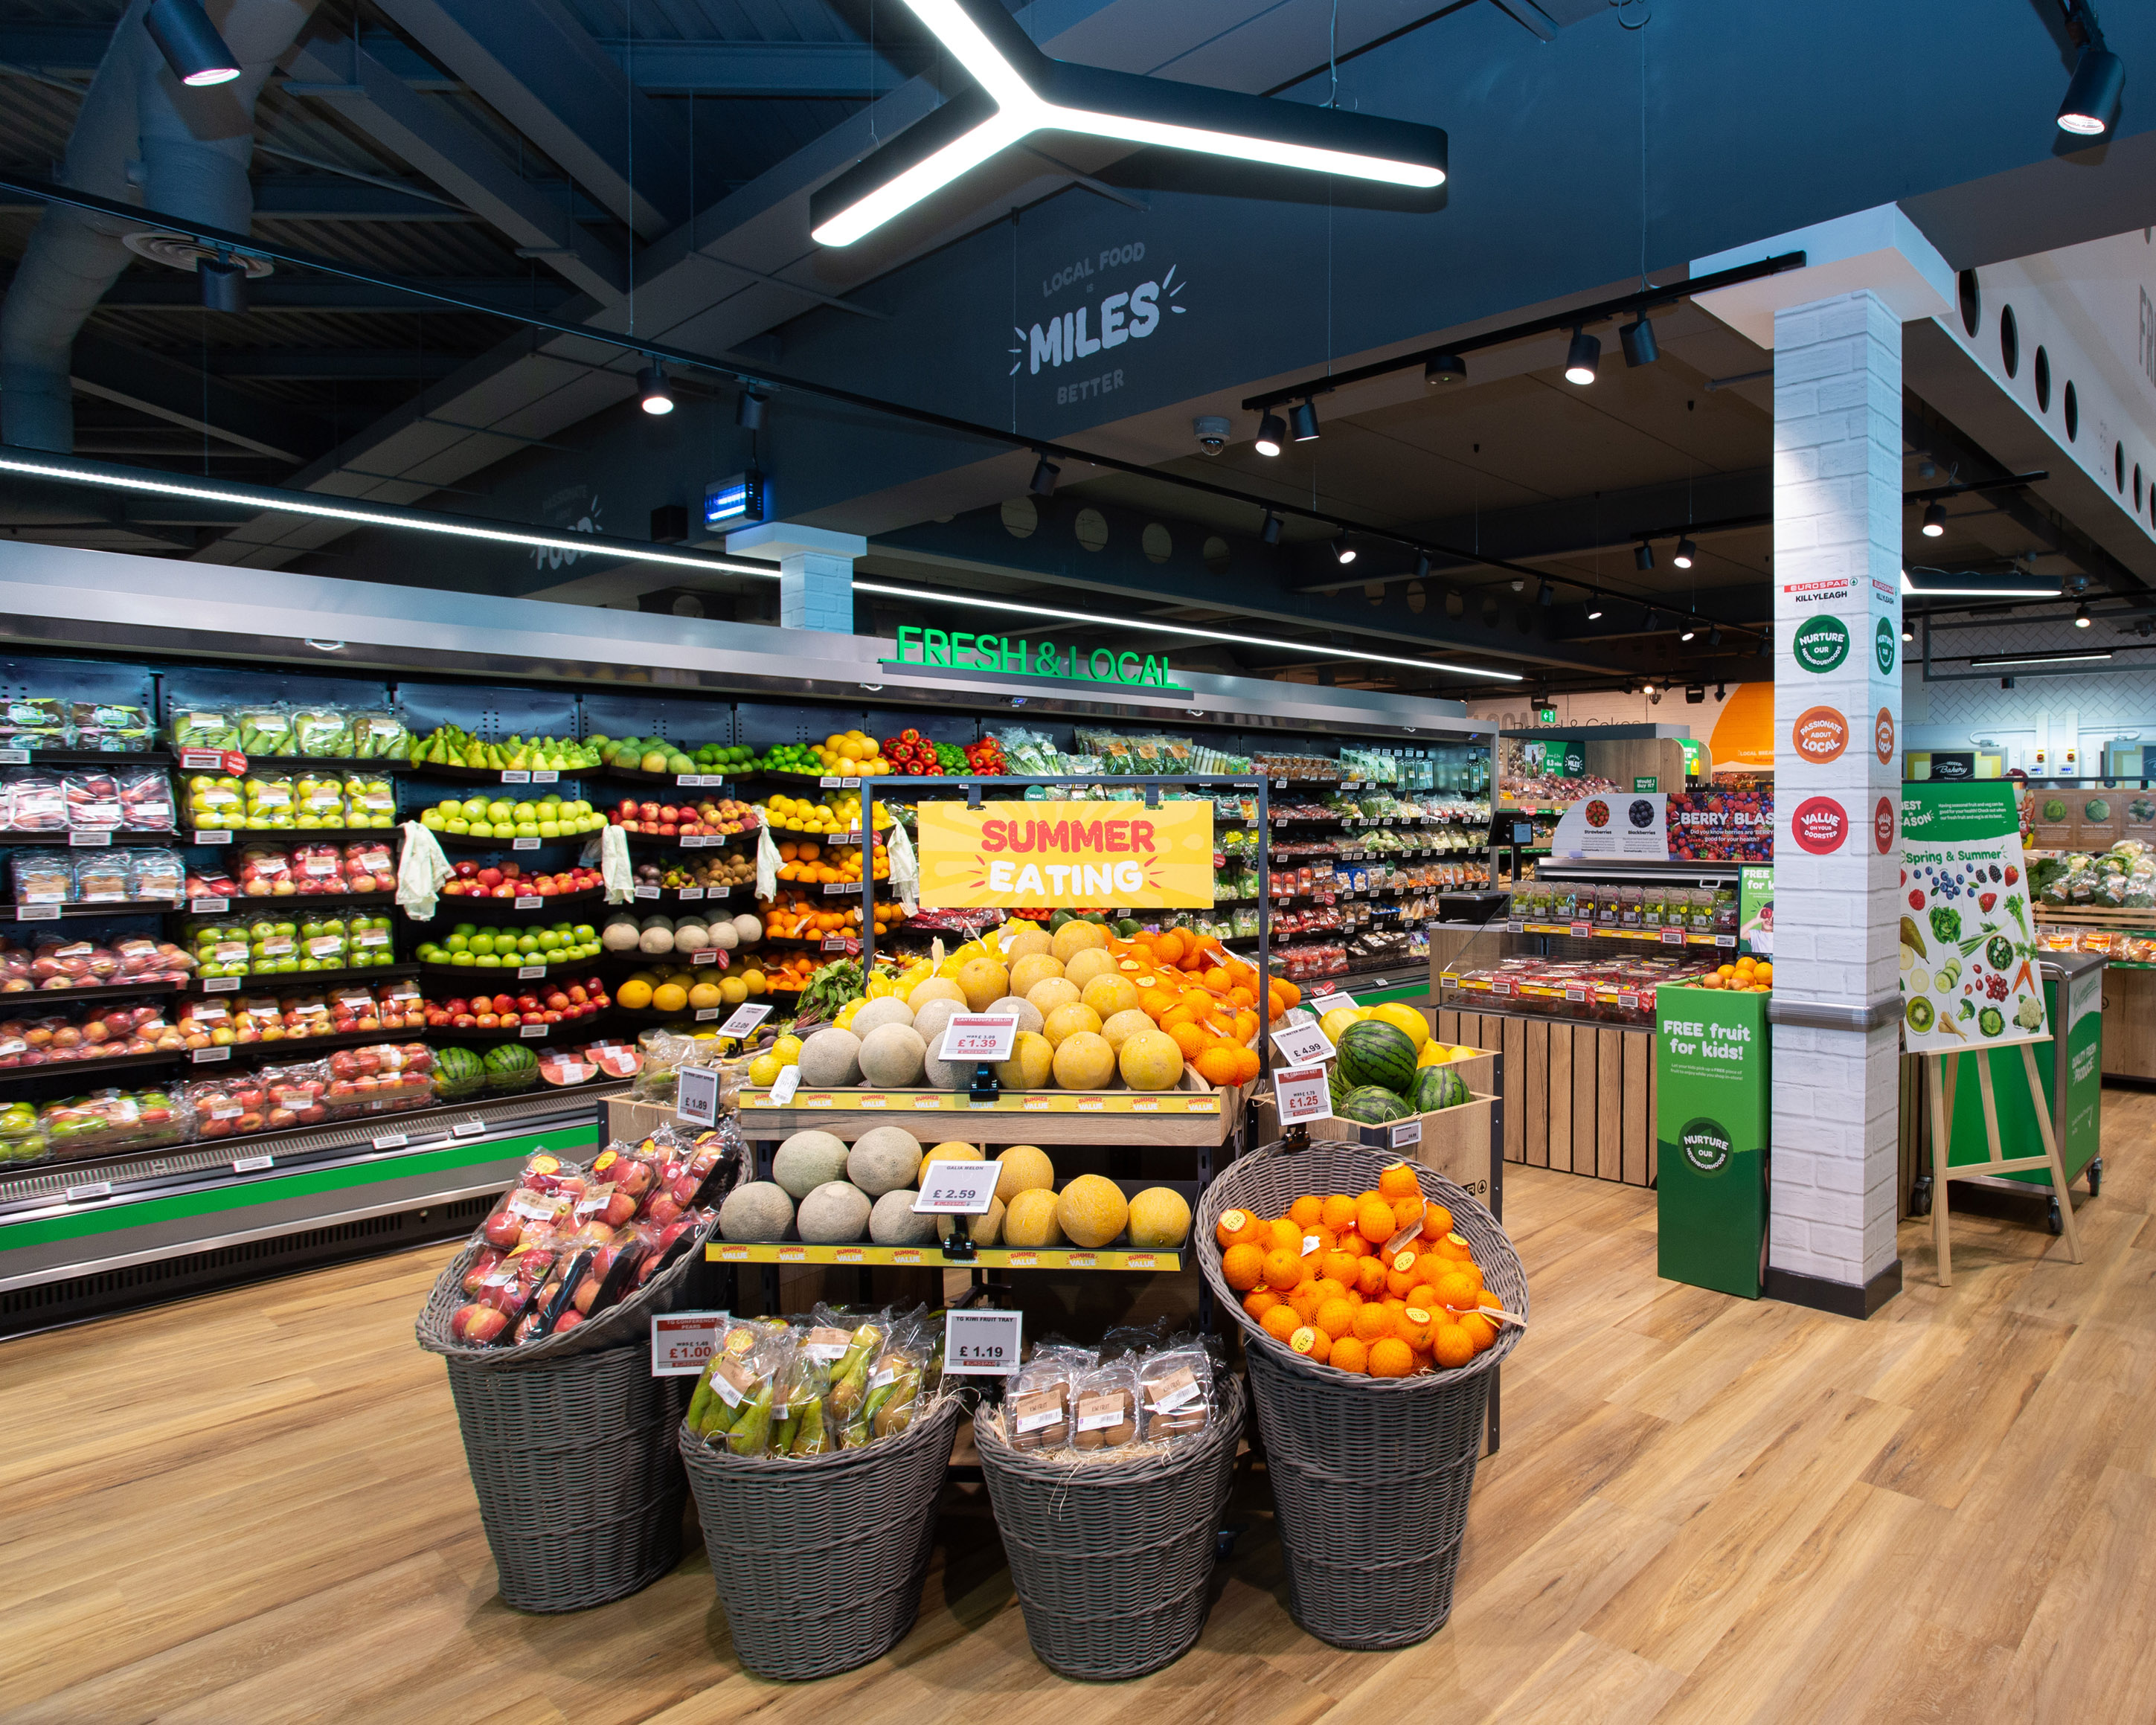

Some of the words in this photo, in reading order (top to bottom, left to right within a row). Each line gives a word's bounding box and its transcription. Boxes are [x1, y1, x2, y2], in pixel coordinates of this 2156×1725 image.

[1043, 257, 1094, 298] LOCAL
[1099, 242, 1146, 271] FOOD
[1030, 280, 1160, 375] MILES
[1057, 369, 1124, 405] BETTER
[1791, 579, 1848, 591] EUROSPAR
[1795, 591, 1847, 603] KILLYLEAGH
[1799, 632, 1845, 646] NURTURE
[897, 626, 1027, 673] FRESH
[1034, 641, 1062, 676] &
[1069, 646, 1178, 687] LOCAL
[1801, 646, 1842, 665] NEIGHBOURHOODS
[1800, 720, 1843, 736] PASSIONATE
[1802, 739, 1841, 753] LOCAL
[1936, 765, 1968, 775] Bakery
[1681, 812, 1730, 825] BERRY
[1800, 812, 1841, 826] VALUE
[1902, 812, 1933, 826] ASON
[981, 820, 1155, 853] SUMMER
[1804, 830, 1838, 839] DOORSTEP
[1906, 850, 1942, 866] Spring
[1946, 851, 1954, 861] &
[1957, 850, 2002, 861] Summer
[989, 860, 1143, 896] EATING
[1743, 869, 1771, 878] FREE
[1747, 880, 1764, 890] for
[1663, 1020, 1704, 1037] FREE
[1710, 1023, 1751, 1042] fruit
[969, 1039, 996, 1047] 1.39
[1302, 1043, 1321, 1055] 4.99
[1669, 1038, 1696, 1055] for
[1702, 1041, 1744, 1061] kids!
[692, 1099, 708, 1111] 1.89
[807, 1099, 832, 1108] VALUE
[915, 1101, 940, 1109] VALUE
[1079, 1102, 1103, 1111] VALUE
[1133, 1103, 1158, 1111] VALUE
[1188, 1103, 1213, 1111] VALUE
[1297, 1095, 1318, 1108] 1.25
[1684, 1135, 1729, 1151] NURTURE
[1686, 1147, 1726, 1169] NEIGHBOURHOODS
[1698, 1149, 1713, 1157] OUR
[945, 1189, 976, 1198] 2.59
[1228, 1215, 1242, 1228] £1.25
[722, 1251, 748, 1259] VALUE
[1010, 1257, 1037, 1265] VALUE
[1398, 1257, 1412, 1269] £1.25
[1297, 1334, 1311, 1351] £1.25
[681, 1346, 712, 1358] 1.00
[973, 1346, 1003, 1358] 1.19
